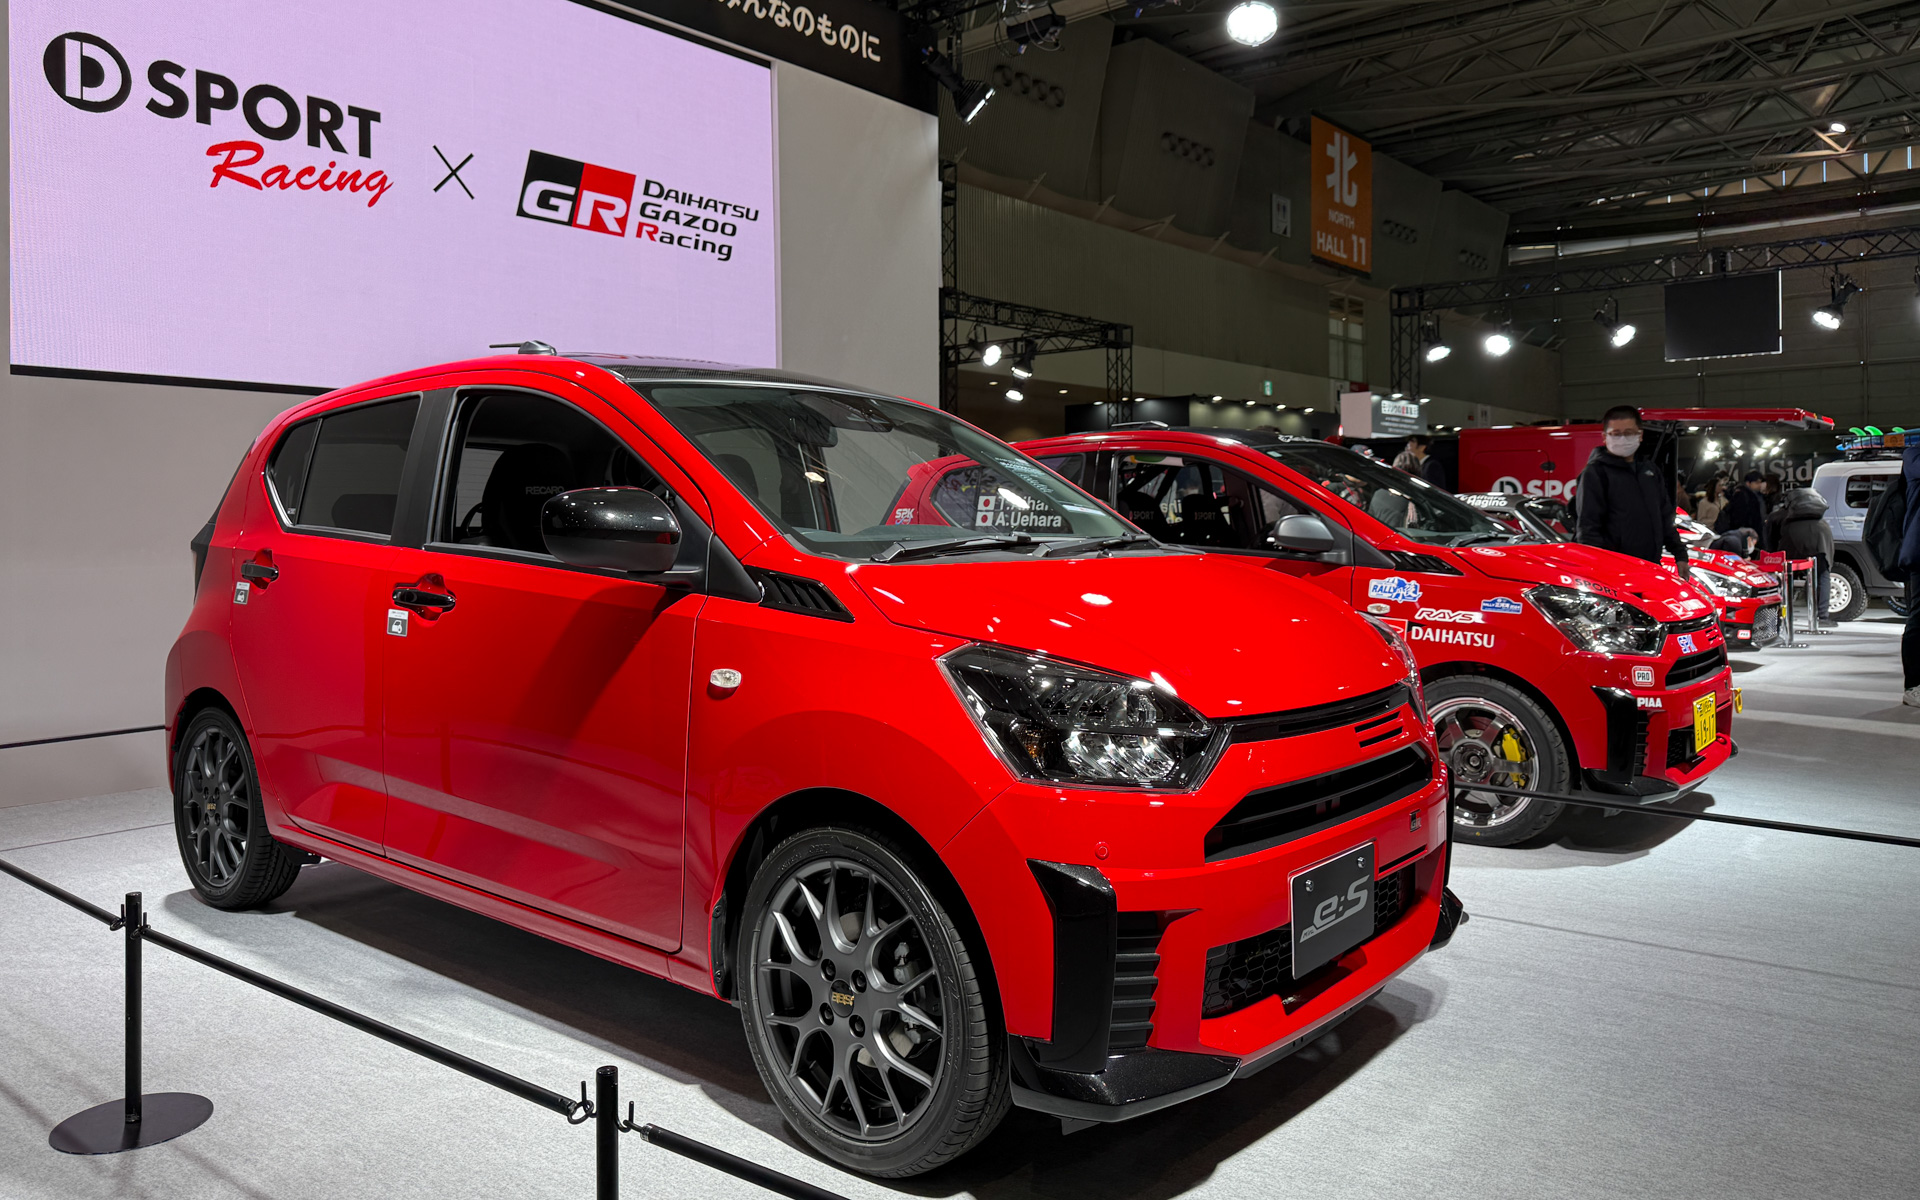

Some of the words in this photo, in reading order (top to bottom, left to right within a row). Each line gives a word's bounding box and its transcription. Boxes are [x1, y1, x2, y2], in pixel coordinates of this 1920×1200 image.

[145, 58, 382, 159] SPORT
[206, 140, 394, 208] Racing
[1325, 131, 1358, 208] 北
[521, 178, 629, 234] GR
[643, 179, 759, 221] DAIHATSU
[639, 201, 738, 237] GAZOO
[1328, 208, 1355, 229] NORTH
[635, 221, 733, 262] Racing
[1316, 230, 1348, 259] HALL
[1351, 233, 1367, 266] 11
[525, 485, 565, 495] RECARO
[995, 511, 1062, 527] A.Uehara
[1371, 584, 1397, 594] RALLY
[1574, 578, 1619, 598] SPORT
[1415, 608, 1477, 623] RAYS
[1411, 625, 1496, 649] DAIHATSU
[1636, 671, 1651, 681] PRO
[1636, 697, 1662, 708] PIAA
[832, 991, 854, 1006] BBS
